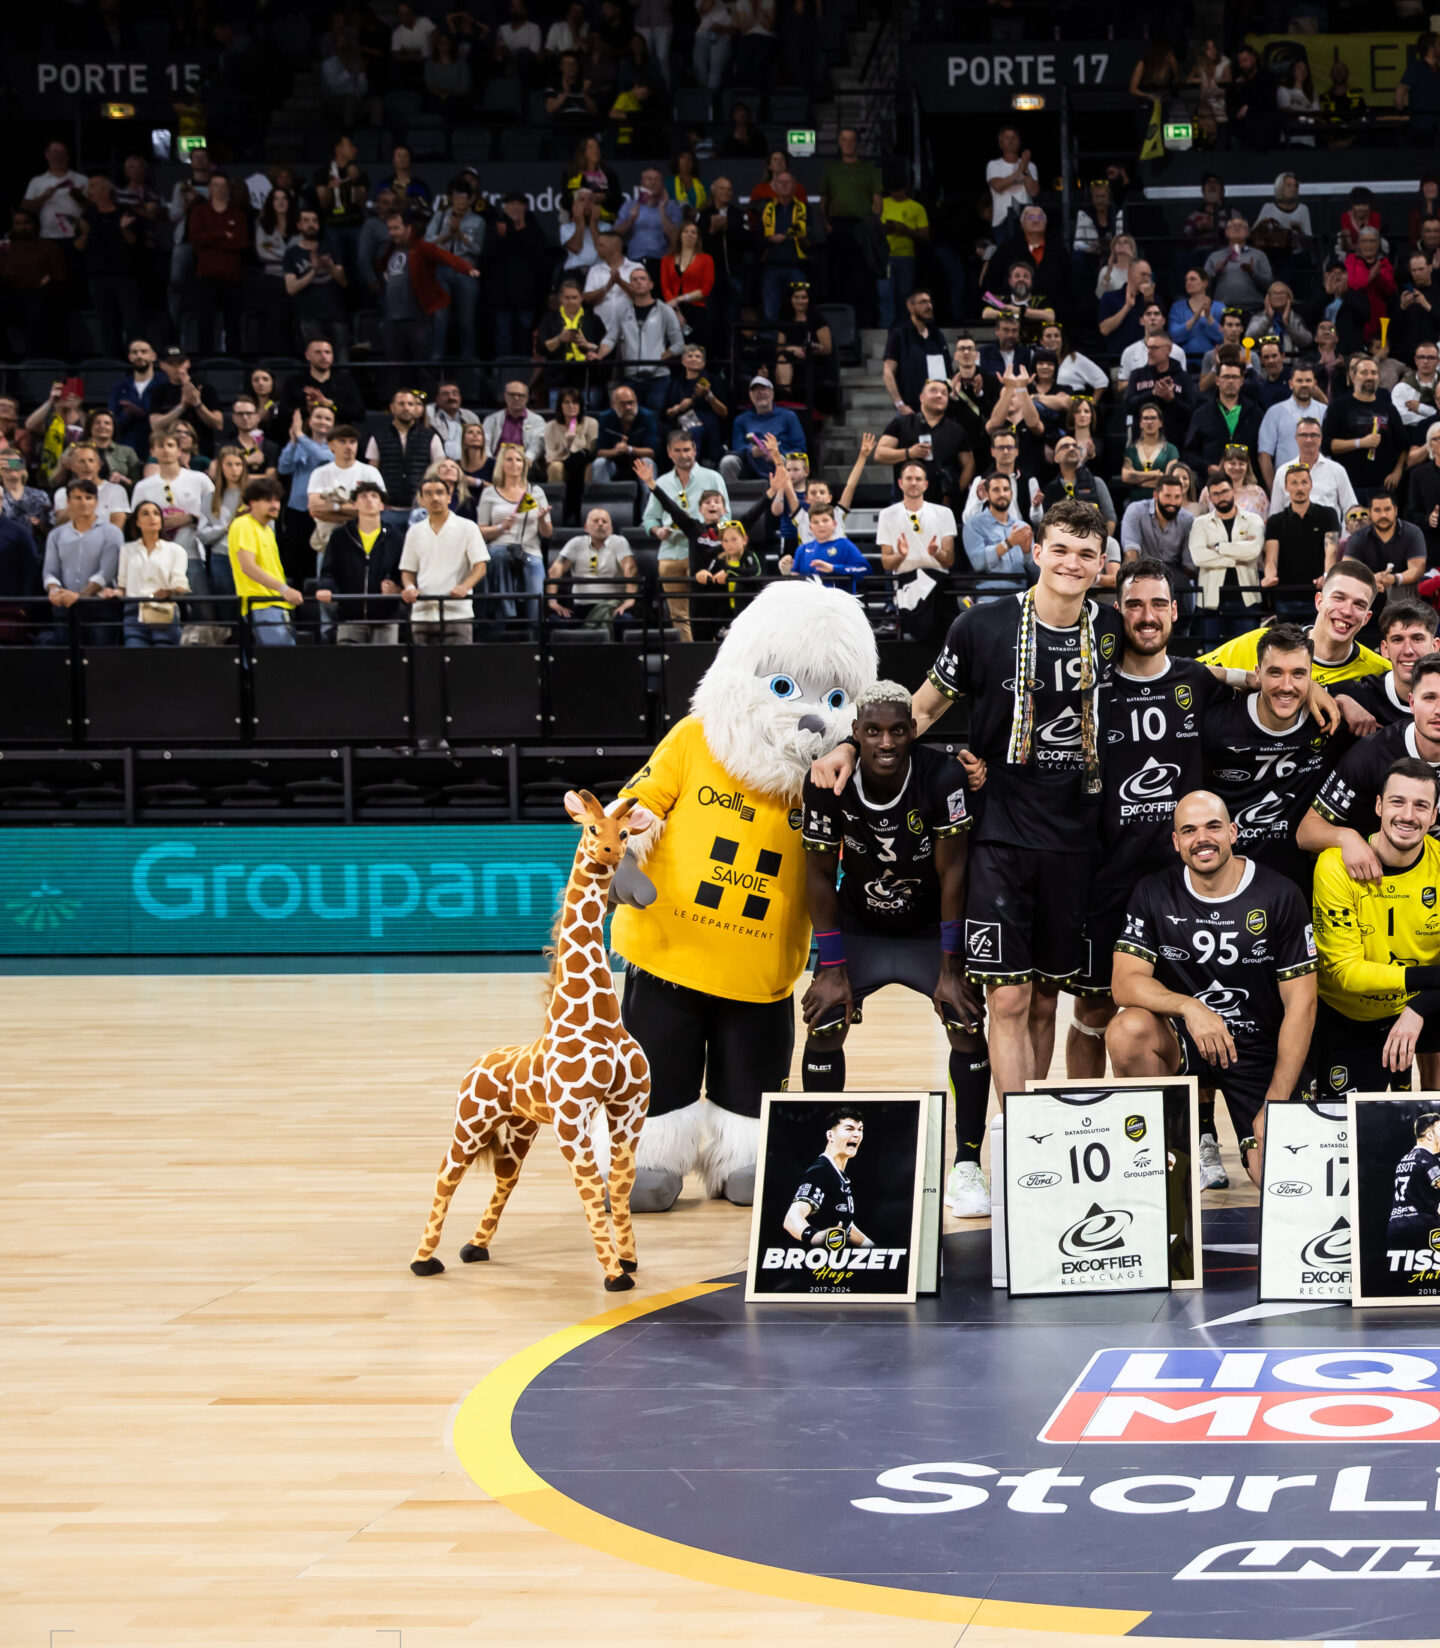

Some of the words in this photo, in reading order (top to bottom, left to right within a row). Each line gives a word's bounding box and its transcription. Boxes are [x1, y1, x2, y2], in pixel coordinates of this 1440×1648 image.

[37, 64, 149, 94] PORTE
[165, 64, 201, 95] 15
[948, 56, 1056, 86] PORTE
[1073, 54, 1109, 84] 17
[1054, 657, 1081, 691] 19
[1131, 707, 1166, 742] 10
[1254, 752, 1297, 782] 76
[874, 835, 897, 862] 3
[132, 841, 564, 938] Groupam
[712, 866, 769, 894] SAVOIE
[674, 908, 686, 918] LE
[692, 916, 775, 940] DÉPARTEMENT
[1388, 906, 1394, 936] 1
[1192, 930, 1239, 966] 95
[1065, 1127, 1110, 1136] DATASOLUTION
[1070, 1142, 1110, 1184] 10
[1123, 1169, 1165, 1178] Groupama
[762, 1248, 907, 1270] BROUZET
[1062, 1254, 1142, 1274] EXCOFFIER
[812, 1266, 854, 1284] Hugo
[1061, 1270, 1144, 1285] RECYCLAGE
[1302, 1271, 1352, 1283] EXCOF
[1300, 1286, 1352, 1295] RECYCL
